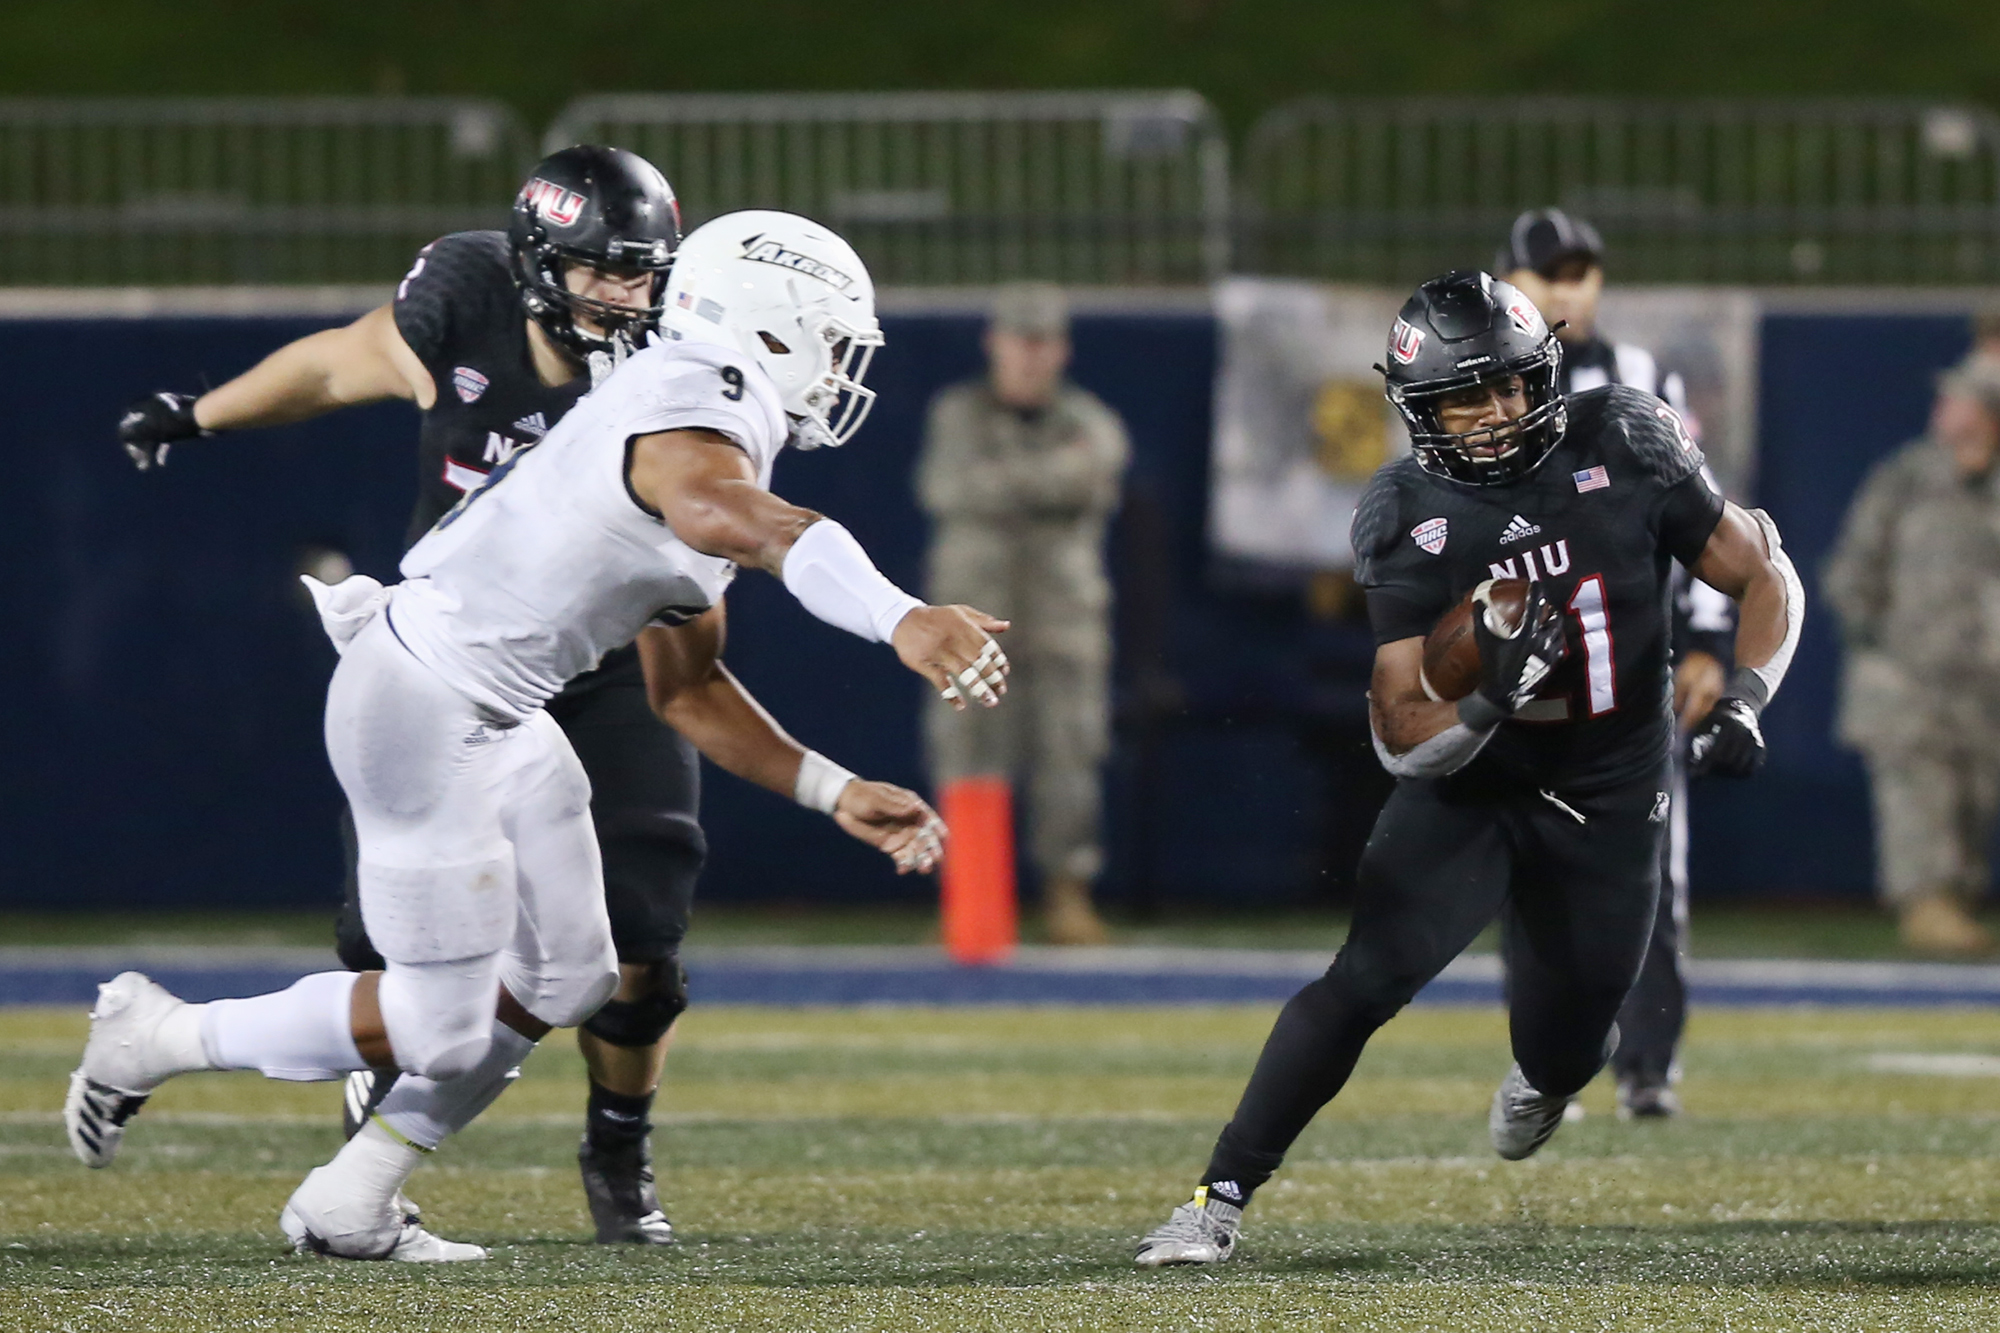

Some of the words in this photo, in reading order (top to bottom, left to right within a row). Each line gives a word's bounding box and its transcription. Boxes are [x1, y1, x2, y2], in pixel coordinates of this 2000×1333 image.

[721, 365, 744, 402] 9
[1414, 524, 1448, 547] MAC
[1500, 524, 1541, 545] adidas
[1488, 538, 1572, 582] NIU
